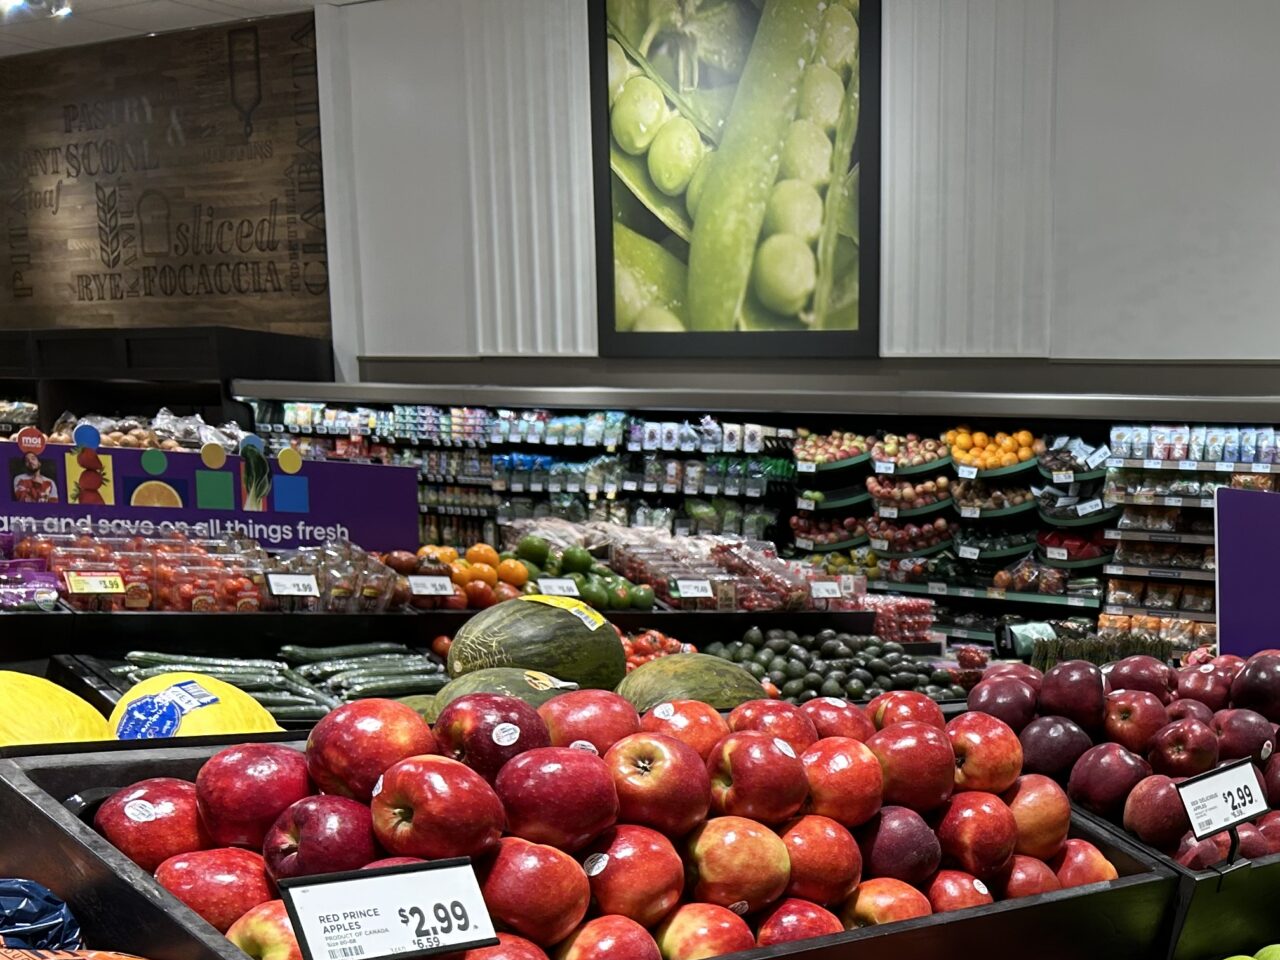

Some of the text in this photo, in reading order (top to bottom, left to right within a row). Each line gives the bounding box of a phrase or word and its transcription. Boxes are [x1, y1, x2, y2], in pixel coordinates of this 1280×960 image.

[174, 198, 280, 257] sliced
[77, 273, 124, 302] RYE
[142, 260, 283, 298] FOCACCIA
[22, 436, 41, 446] moi
[43, 514, 92, 533] and
[98, 519, 154, 535] save
[225, 519, 293, 543] things
[297, 520, 350, 541] fresh
[1222, 784, 1254, 811] $2.99
[318, 908, 381, 924] RED PRINCE
[323, 921, 362, 935] APPLES
[397, 900, 470, 938] $2.99
[364, 927, 390, 937] CANADA
